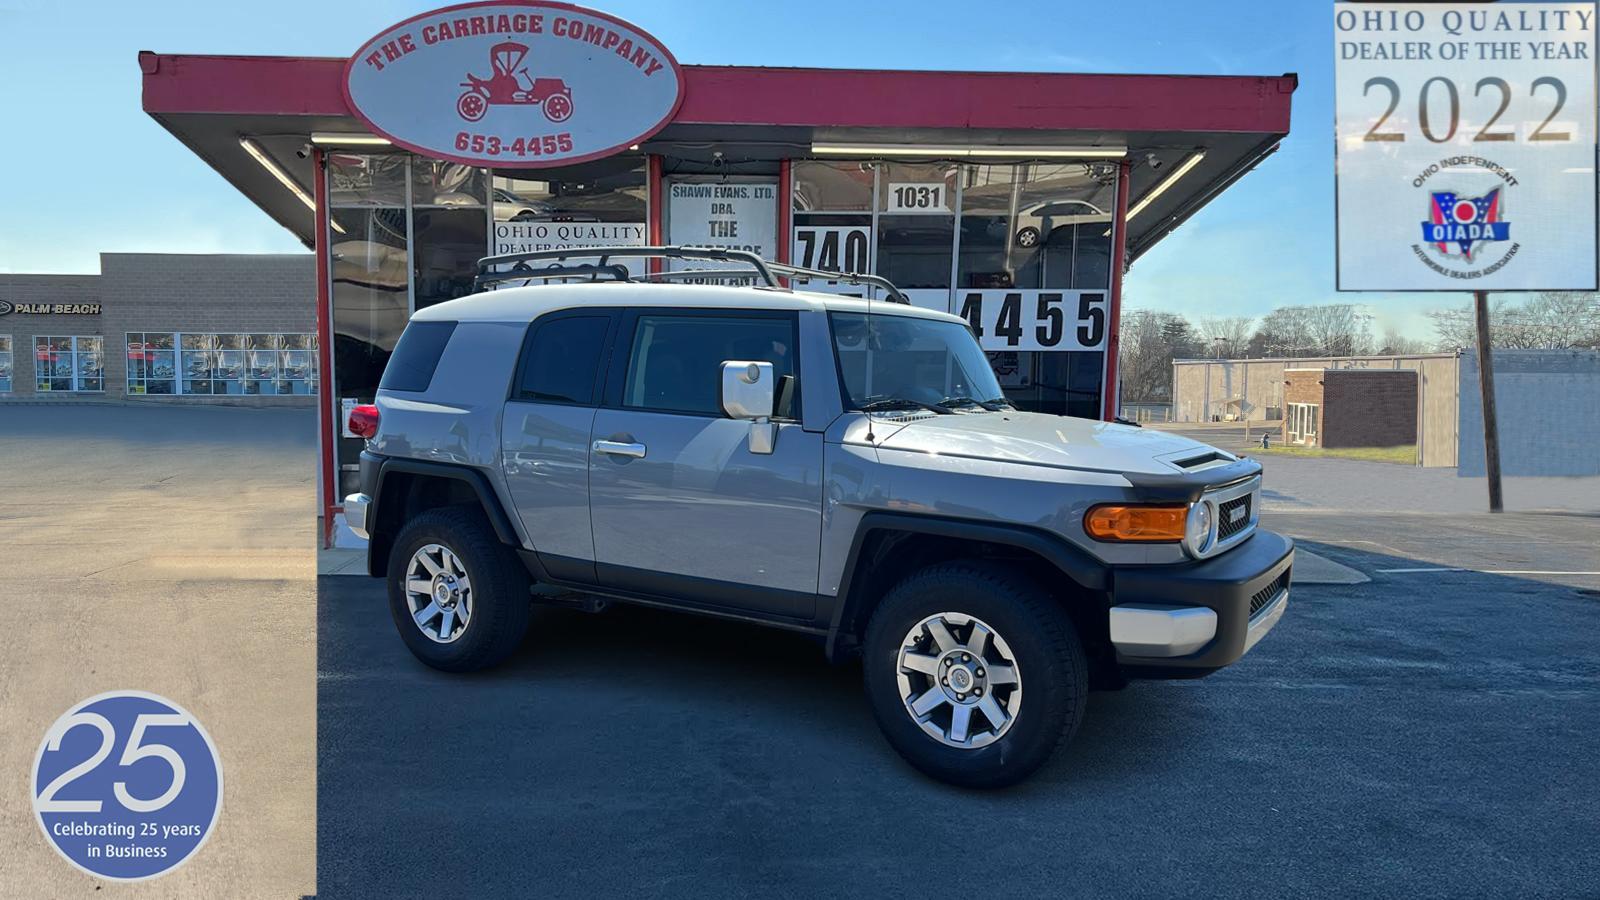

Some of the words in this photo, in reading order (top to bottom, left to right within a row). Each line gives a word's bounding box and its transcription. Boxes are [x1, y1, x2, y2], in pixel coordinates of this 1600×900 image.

[1337, 10, 1424, 31] OHIO
[1442, 10, 1593, 35] QUALITY
[365, 33, 417, 72] THE
[422, 14, 544, 45] CARRIAGE
[552, 17, 664, 77] COMPANY
[1340, 41, 1433, 60] DEALER
[1439, 41, 1469, 60] OF
[1475, 41, 1521, 60] THE
[1528, 41, 1589, 60] YEAR
[1362, 76, 1571, 143] 2022
[455, 132, 573, 157] 653-4455
[1412, 164, 1439, 188] OHIO
[1440, 156, 1519, 187] INDEPENDENT
[673, 186, 712, 198] SHAWN
[754, 187, 775, 199] LTD.
[894, 187, 940, 208] 1031
[711, 203, 736, 215] DBA.
[497, 226, 548, 239] OHIO
[558, 226, 644, 240] QUALITY
[709, 221, 738, 237] THE
[1433, 225, 1495, 240] OIADA
[798, 230, 868, 285] 740
[15, 304, 51, 314] PALM
[54, 304, 100, 314] BEACH
[960, 293, 1105, 347] 4455
